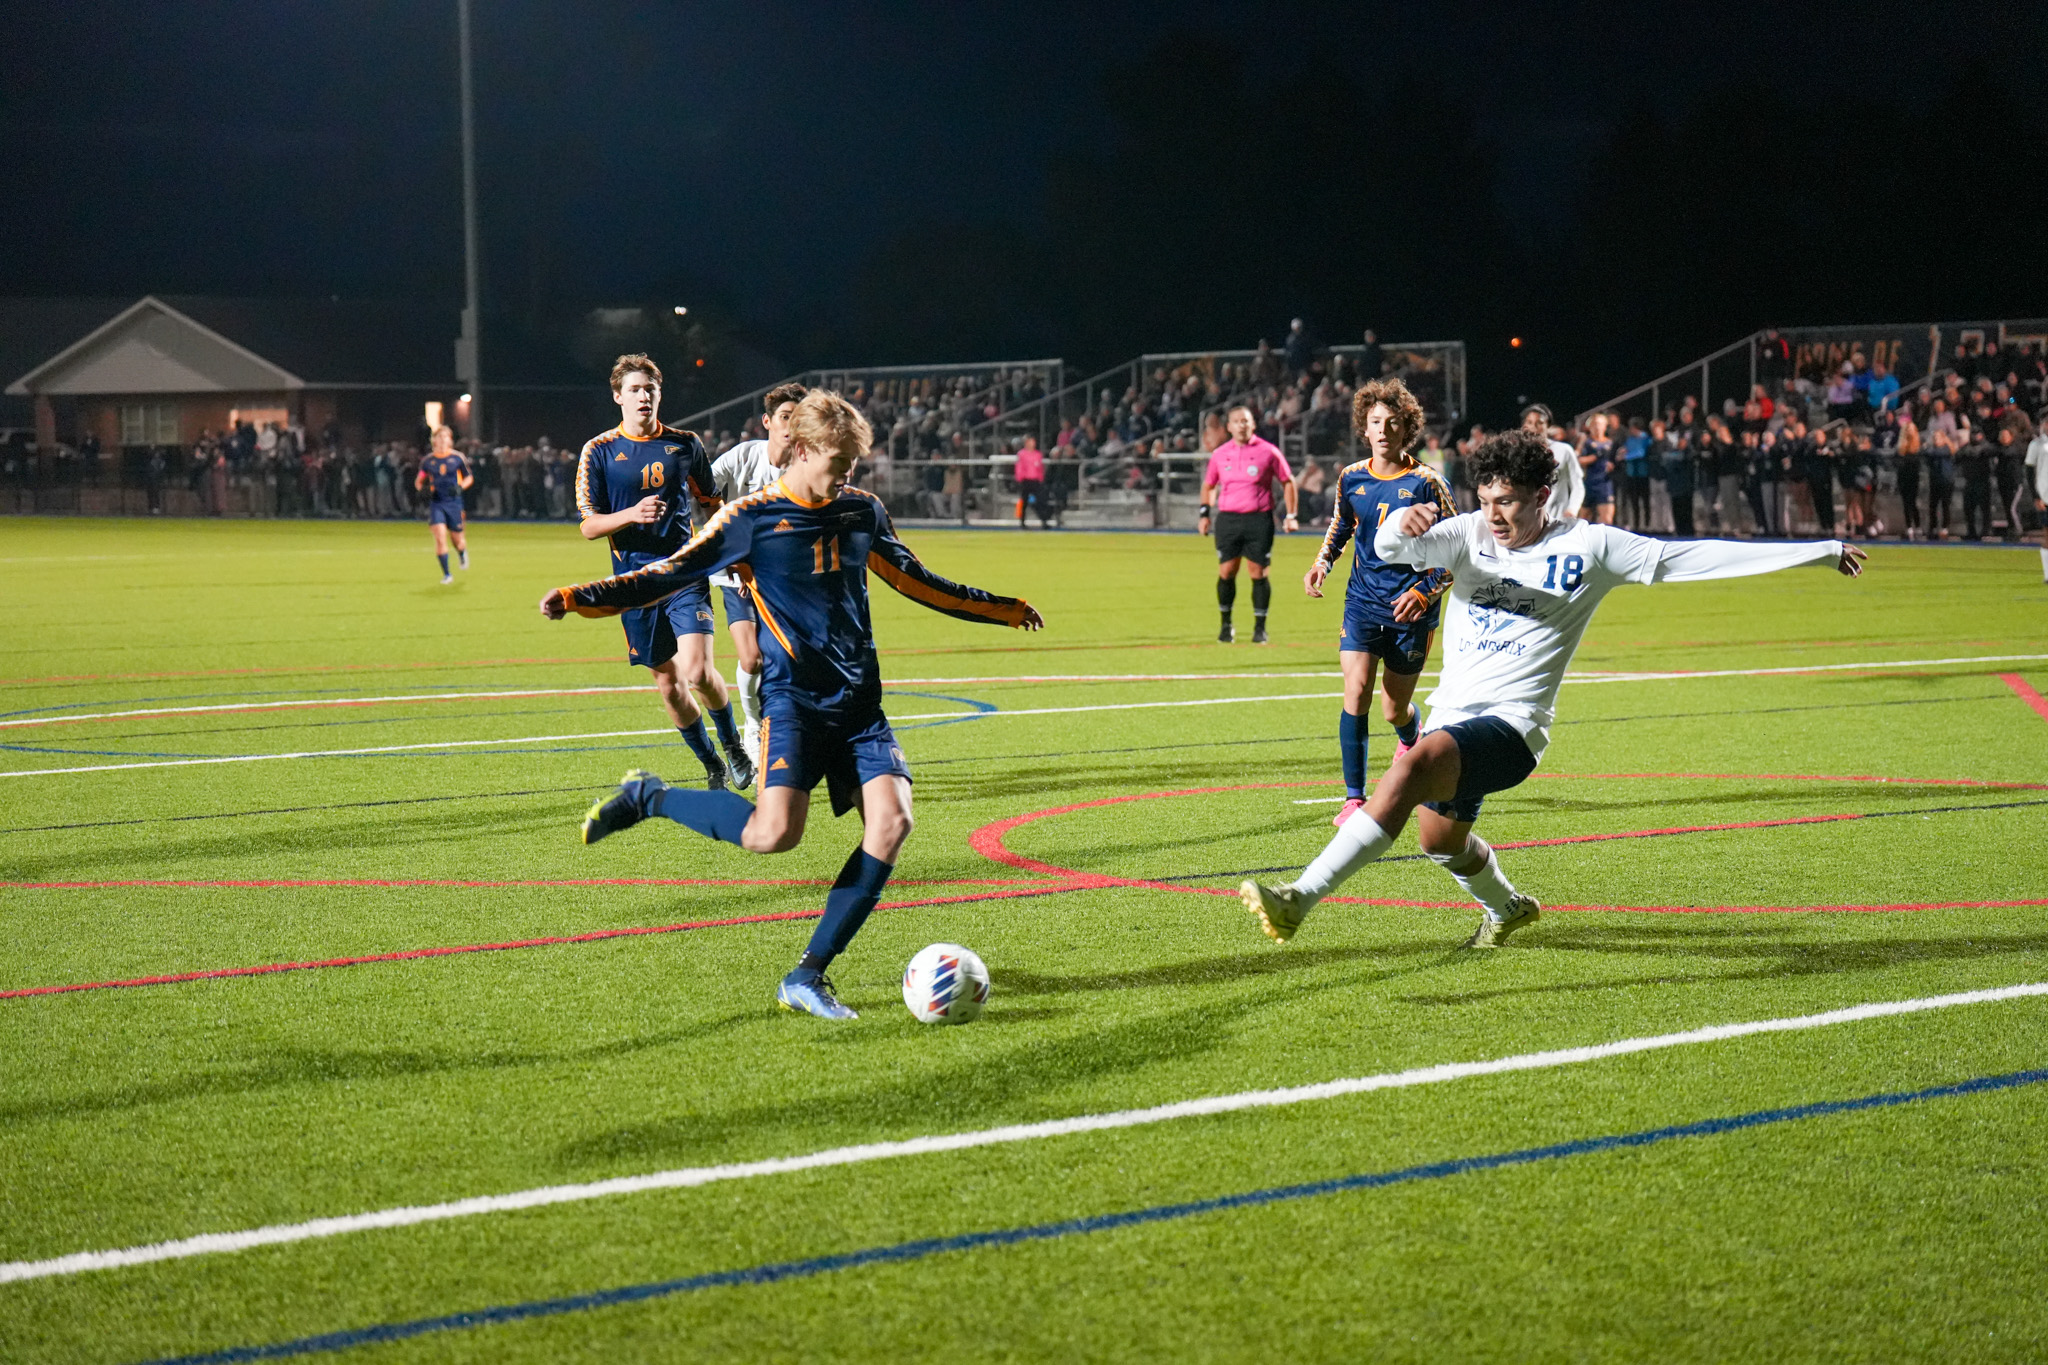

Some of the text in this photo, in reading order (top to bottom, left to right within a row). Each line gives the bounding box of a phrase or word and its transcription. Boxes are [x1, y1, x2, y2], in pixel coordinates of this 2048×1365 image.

[640, 461, 665, 490] 18
[811, 533, 842, 575] 11
[1542, 554, 1584, 592] 18
